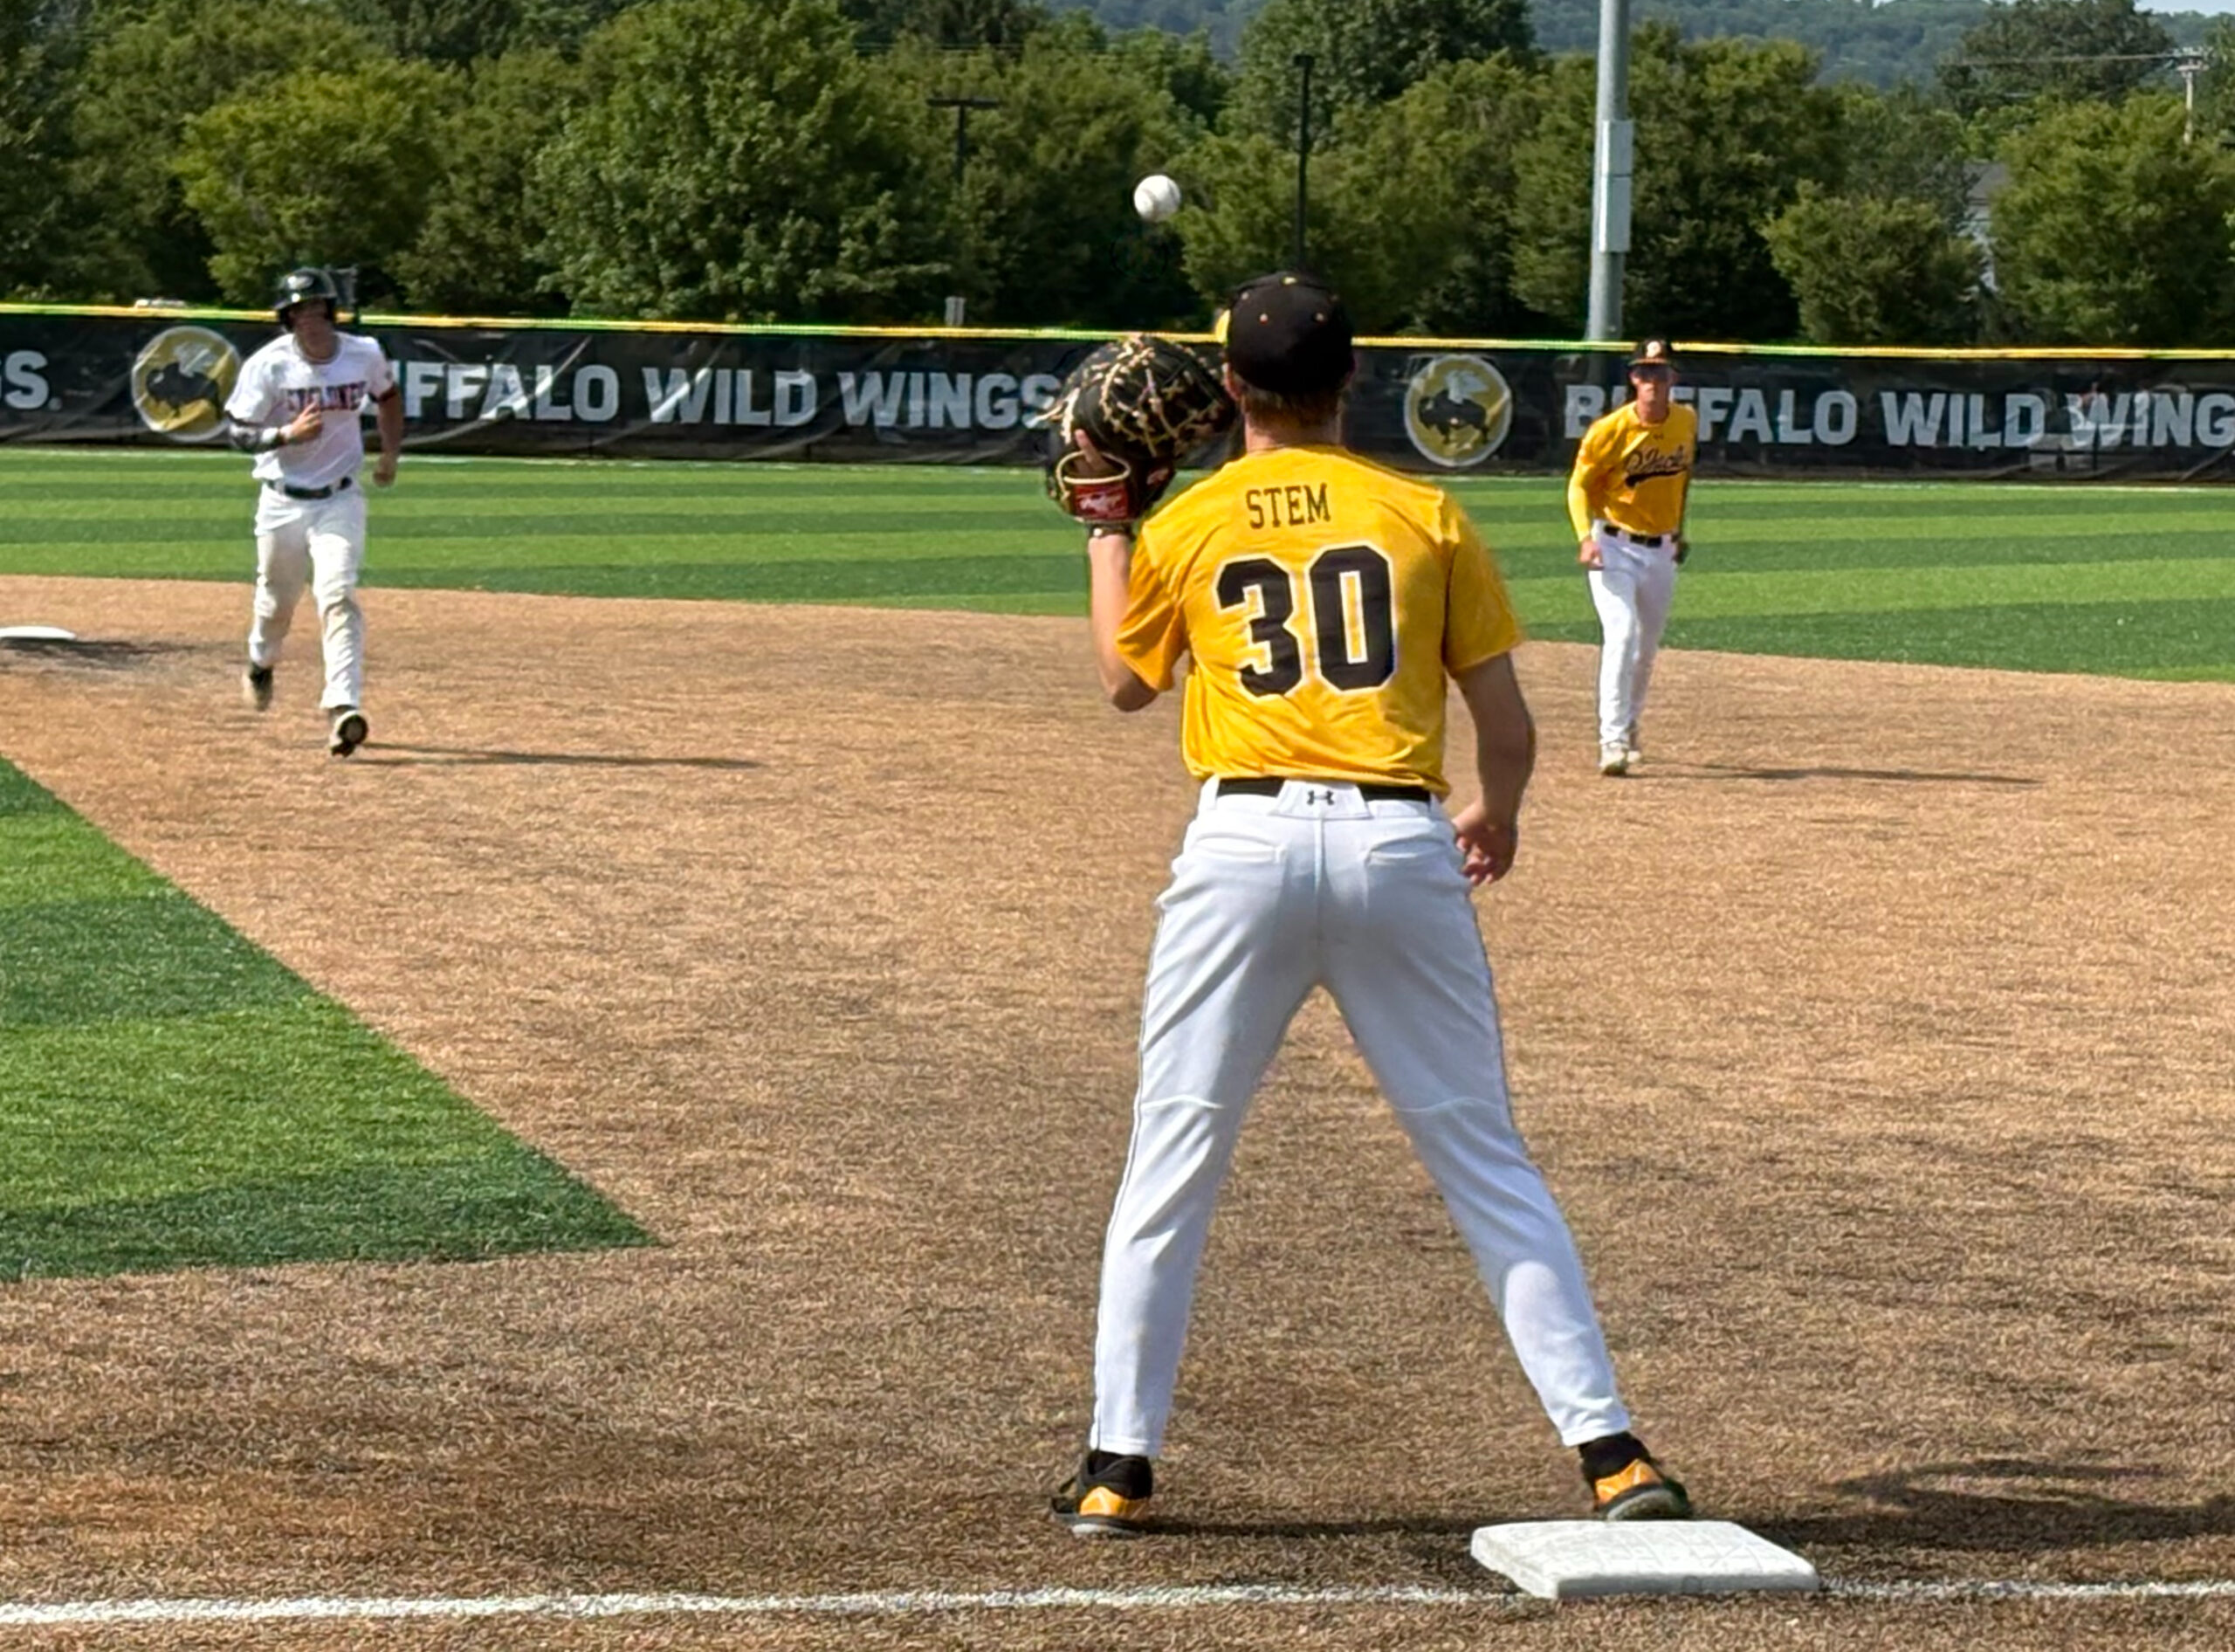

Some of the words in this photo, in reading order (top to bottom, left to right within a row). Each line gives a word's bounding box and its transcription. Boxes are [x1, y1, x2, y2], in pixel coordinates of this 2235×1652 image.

[643, 368, 818, 426] WILD
[1881, 391, 2046, 447] WILD
[2066, 393, 2235, 448] WING
[1246, 482, 1331, 530] STEM
[1213, 543, 1398, 699] 30
